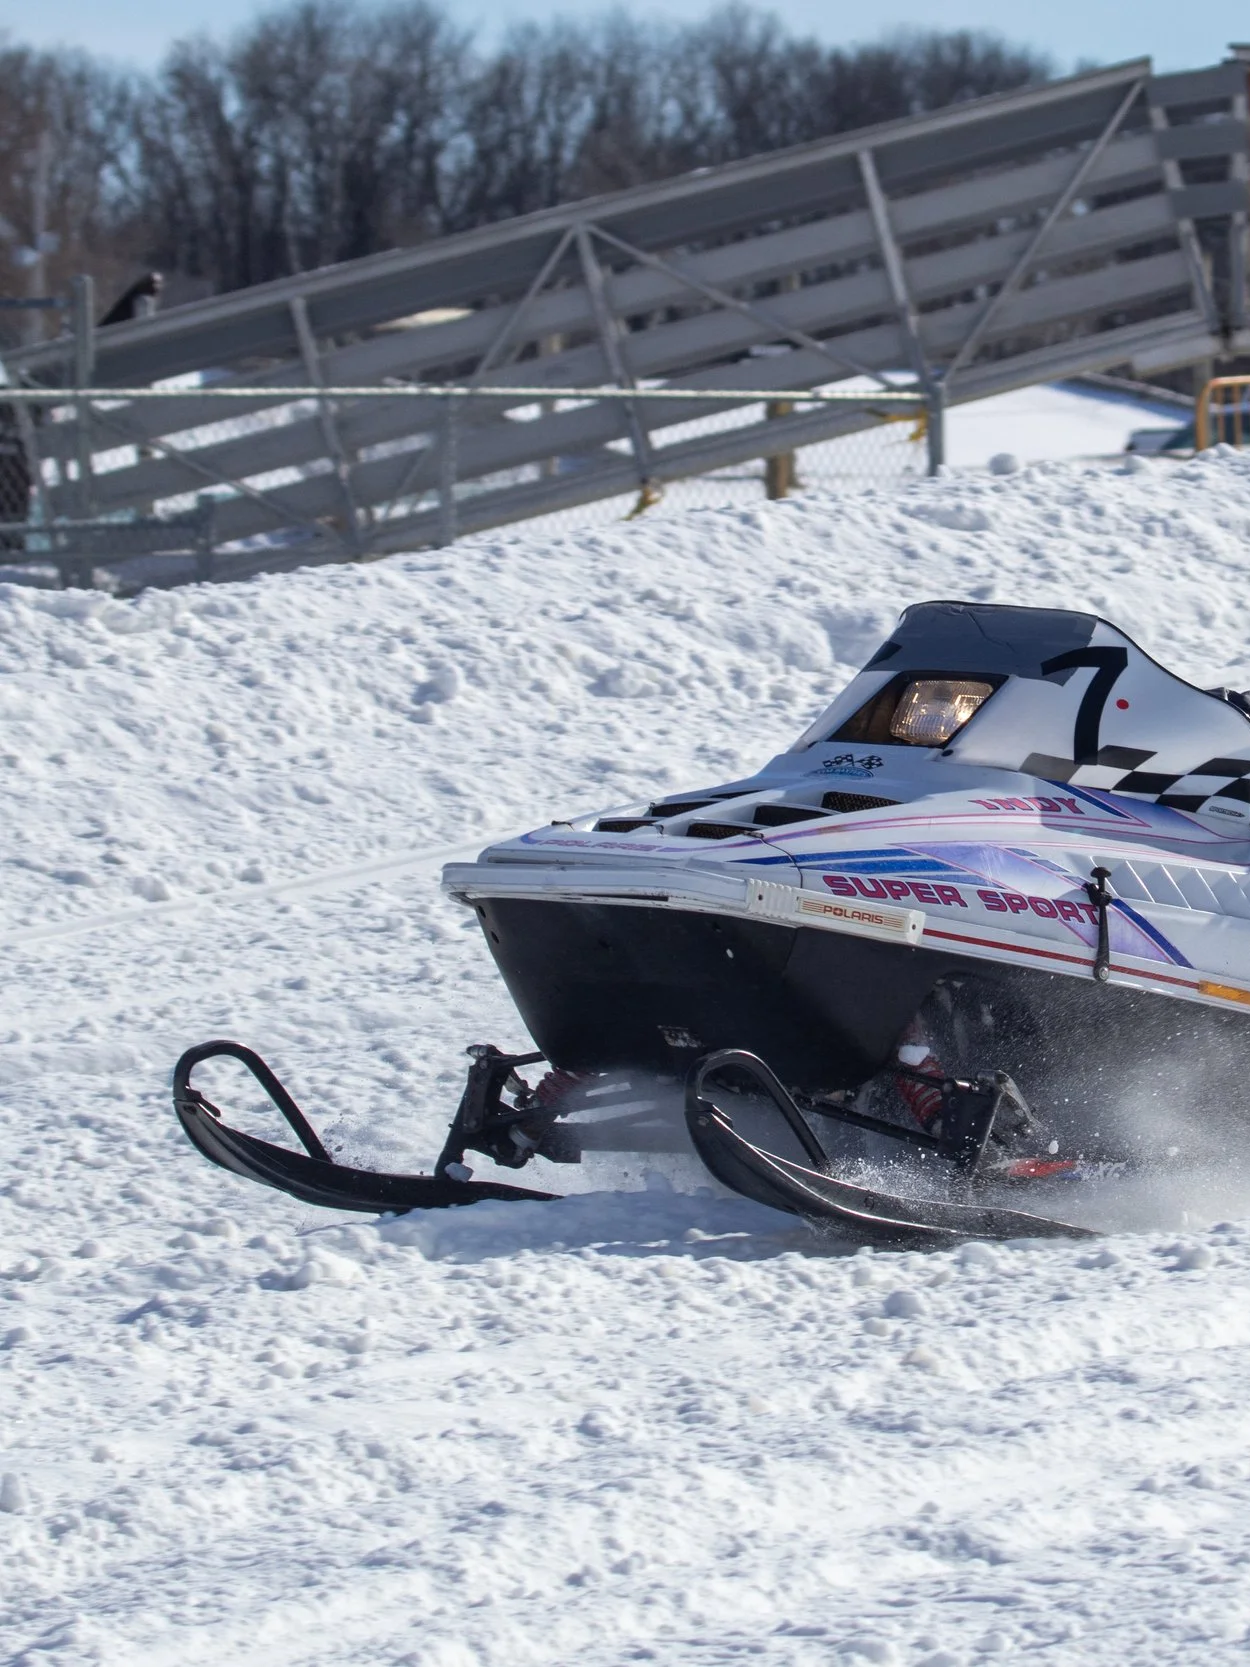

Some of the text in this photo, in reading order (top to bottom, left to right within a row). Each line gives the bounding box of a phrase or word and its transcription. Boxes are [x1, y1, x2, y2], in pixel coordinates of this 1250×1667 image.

[1040, 646, 1128, 765] 7
[968, 796, 1085, 815] INDY
[822, 875, 1099, 926] SUPER SPORT
[823, 905, 884, 925] POLARIS
